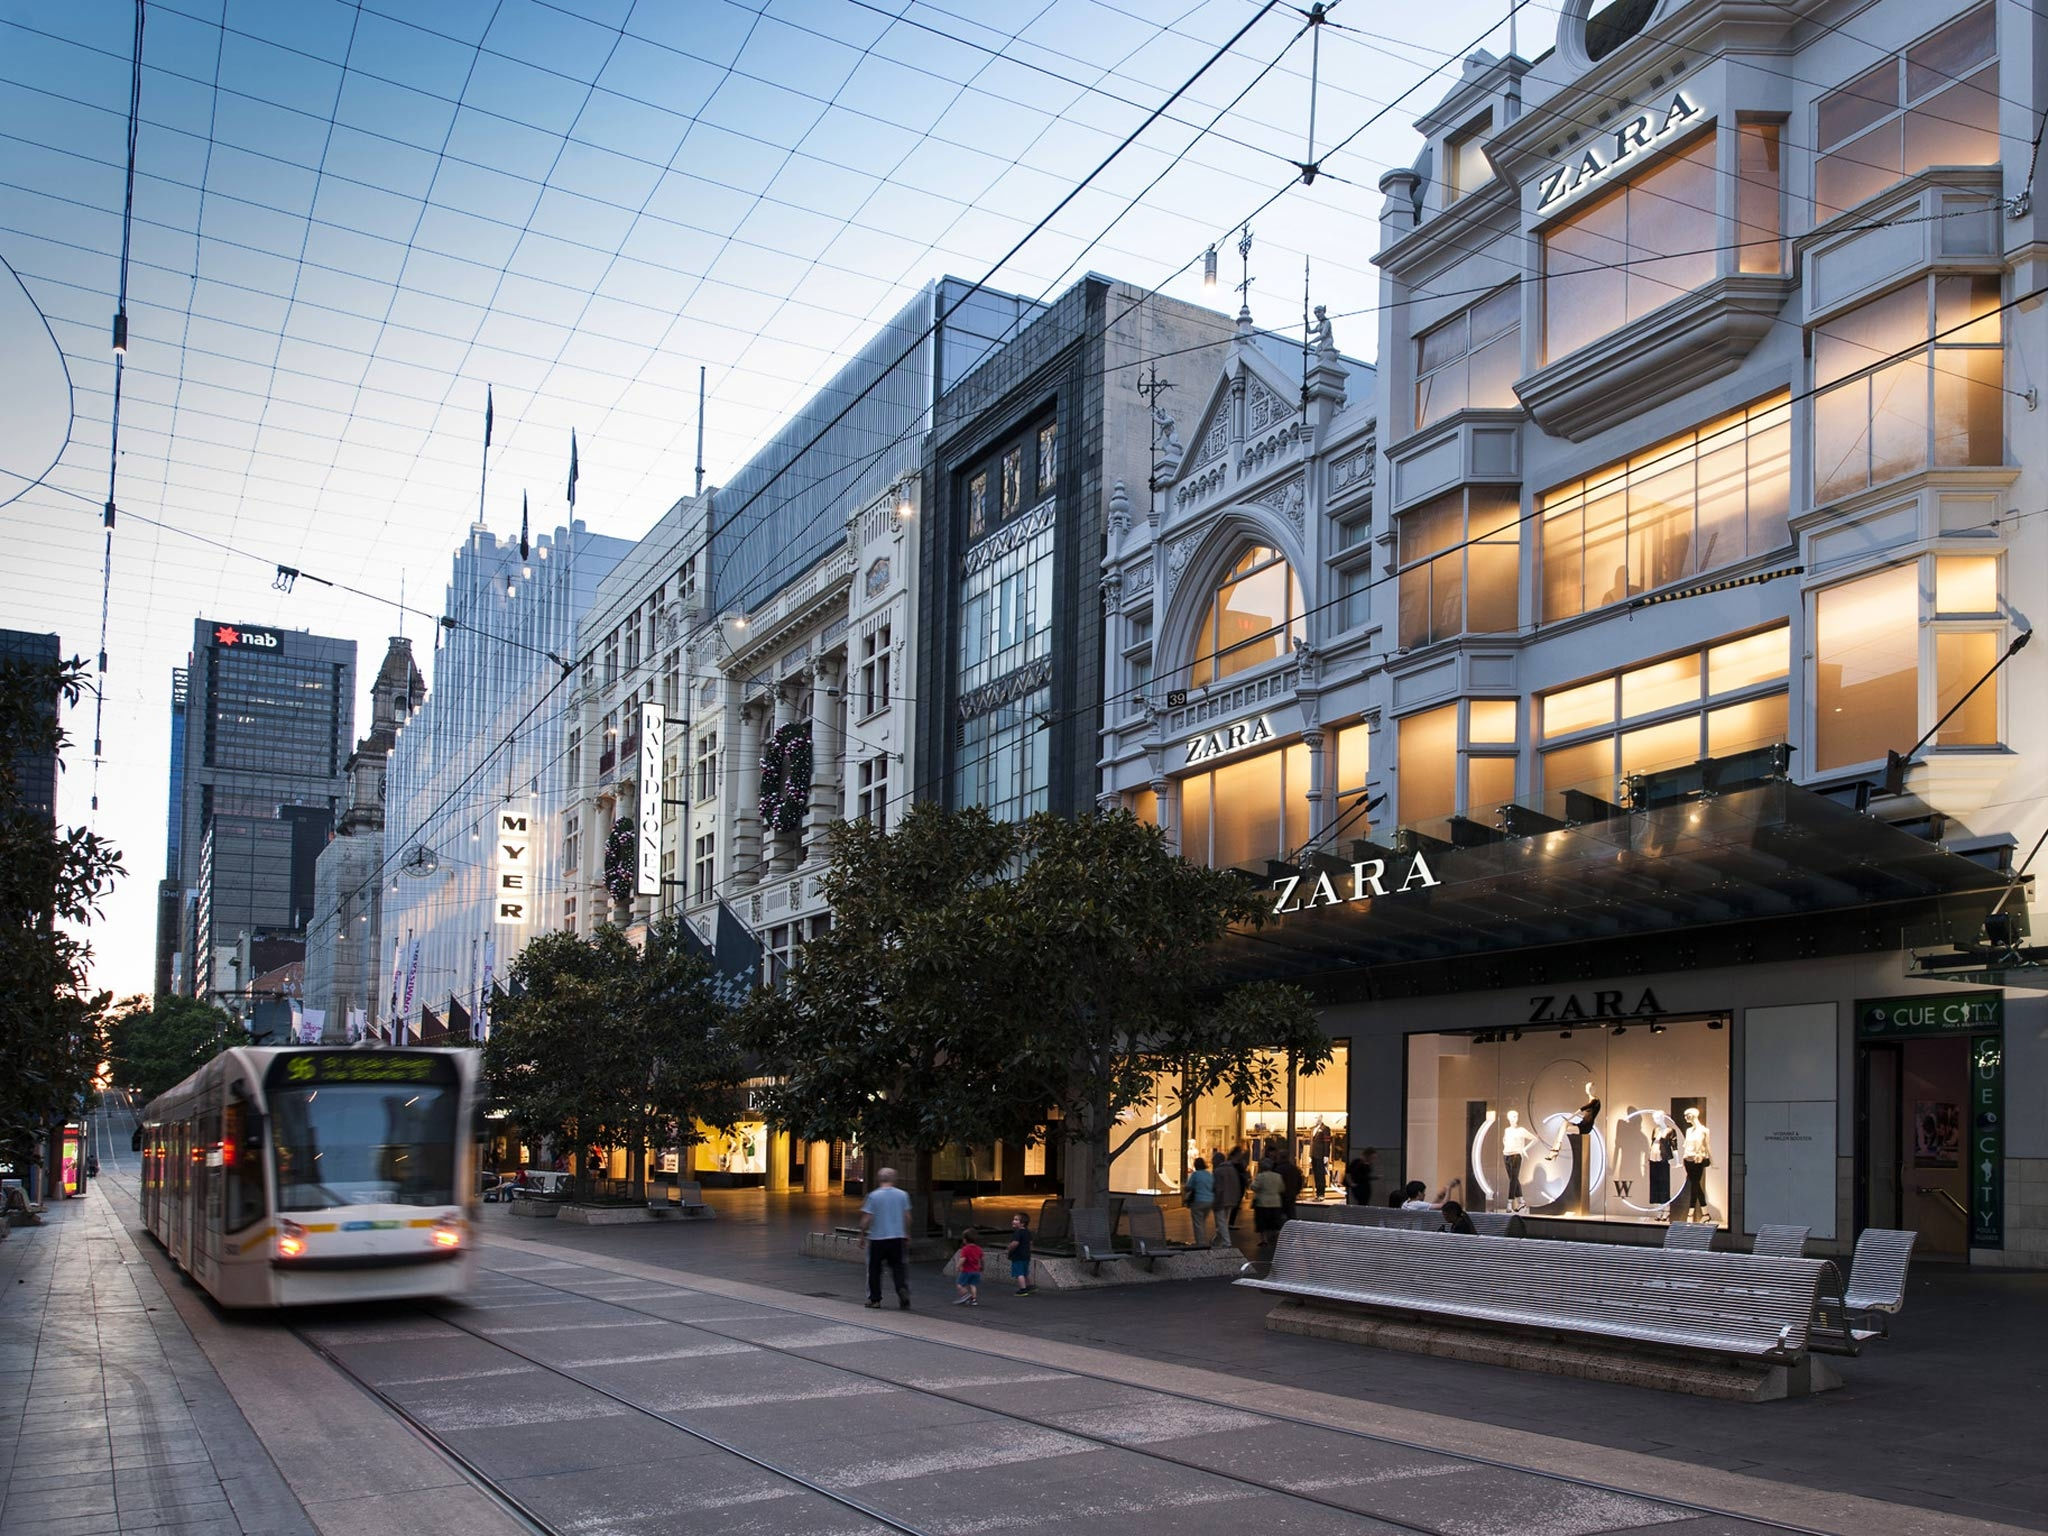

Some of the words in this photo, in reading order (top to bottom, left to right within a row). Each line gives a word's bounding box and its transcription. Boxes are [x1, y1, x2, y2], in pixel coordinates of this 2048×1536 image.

[1537, 93, 1699, 211] ZARA
[241, 632, 278, 648] nab
[1169, 692, 1186, 705] 39
[645, 714, 661, 795] DAVID
[1184, 717, 1272, 764] ZARA
[500, 816, 527, 918] MYER
[643, 803, 659, 883] JONES
[1272, 851, 1441, 915] ZARA
[1528, 987, 1667, 1023] ZARA
[1893, 1006, 1936, 1027] CUE
[1943, 1001, 1998, 1023] CITY
[1980, 1039, 1995, 1104] CUE
[1980, 1137, 1996, 1226] CITY
